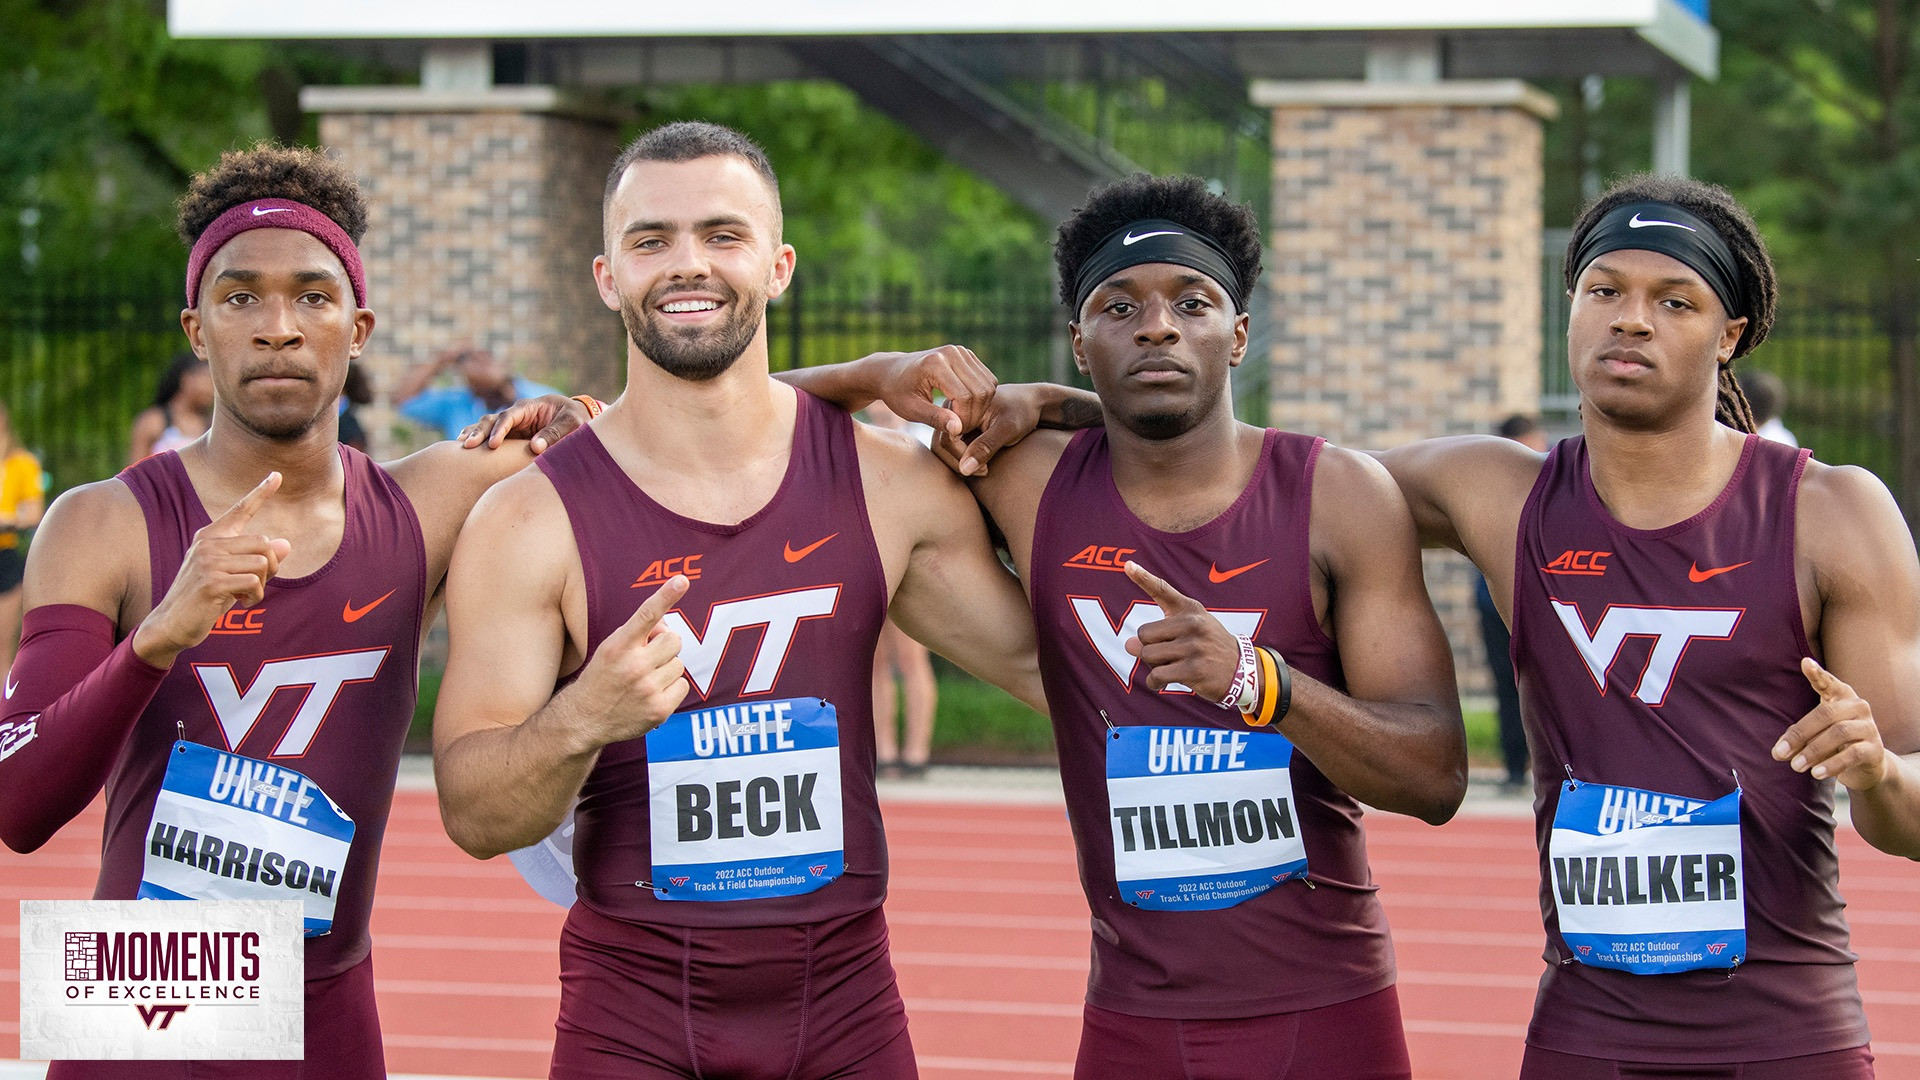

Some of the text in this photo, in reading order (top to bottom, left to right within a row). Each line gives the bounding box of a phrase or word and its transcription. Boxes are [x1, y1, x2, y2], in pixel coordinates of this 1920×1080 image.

[1062, 545, 1137, 572] ACC
[1540, 550, 1613, 576] ACC
[630, 554, 703, 588] ACC
[663, 583, 843, 702] VT
[1549, 596, 1747, 708] VT
[1242, 642, 1255, 665] FIELD
[1247, 671, 1256, 690] VT
[190, 645, 392, 759] VT
[690, 702, 794, 757] UNITE
[733, 724, 759, 735] ACC
[1148, 728, 1250, 774] UNITE
[1187, 744, 1213, 755] ACC
[209, 753, 318, 826] UNITE
[252, 781, 279, 796] ACC
[675, 772, 821, 842] BECK
[1113, 797, 1296, 852] TILLMON
[150, 822, 337, 897] HARRISON
[715, 866, 785, 880] 2022 ACC Outdoor
[809, 865, 828, 877] VT
[1272, 871, 1292, 883] VT
[1553, 853, 1737, 905] WALKER
[669, 876, 690, 887] VT
[694, 875, 806, 891] Track & Field Championships
[1178, 879, 1247, 893] 2022 ACC Outdoor
[1135, 890, 1155, 900] VT
[1160, 884, 1270, 903] Track & Field Championships
[1576, 945, 1592, 955] VT
[1611, 941, 1680, 952] 2022 ACC Outdoor
[1706, 943, 1728, 955] VT
[1596, 952, 1703, 965] Track & Field Championships
